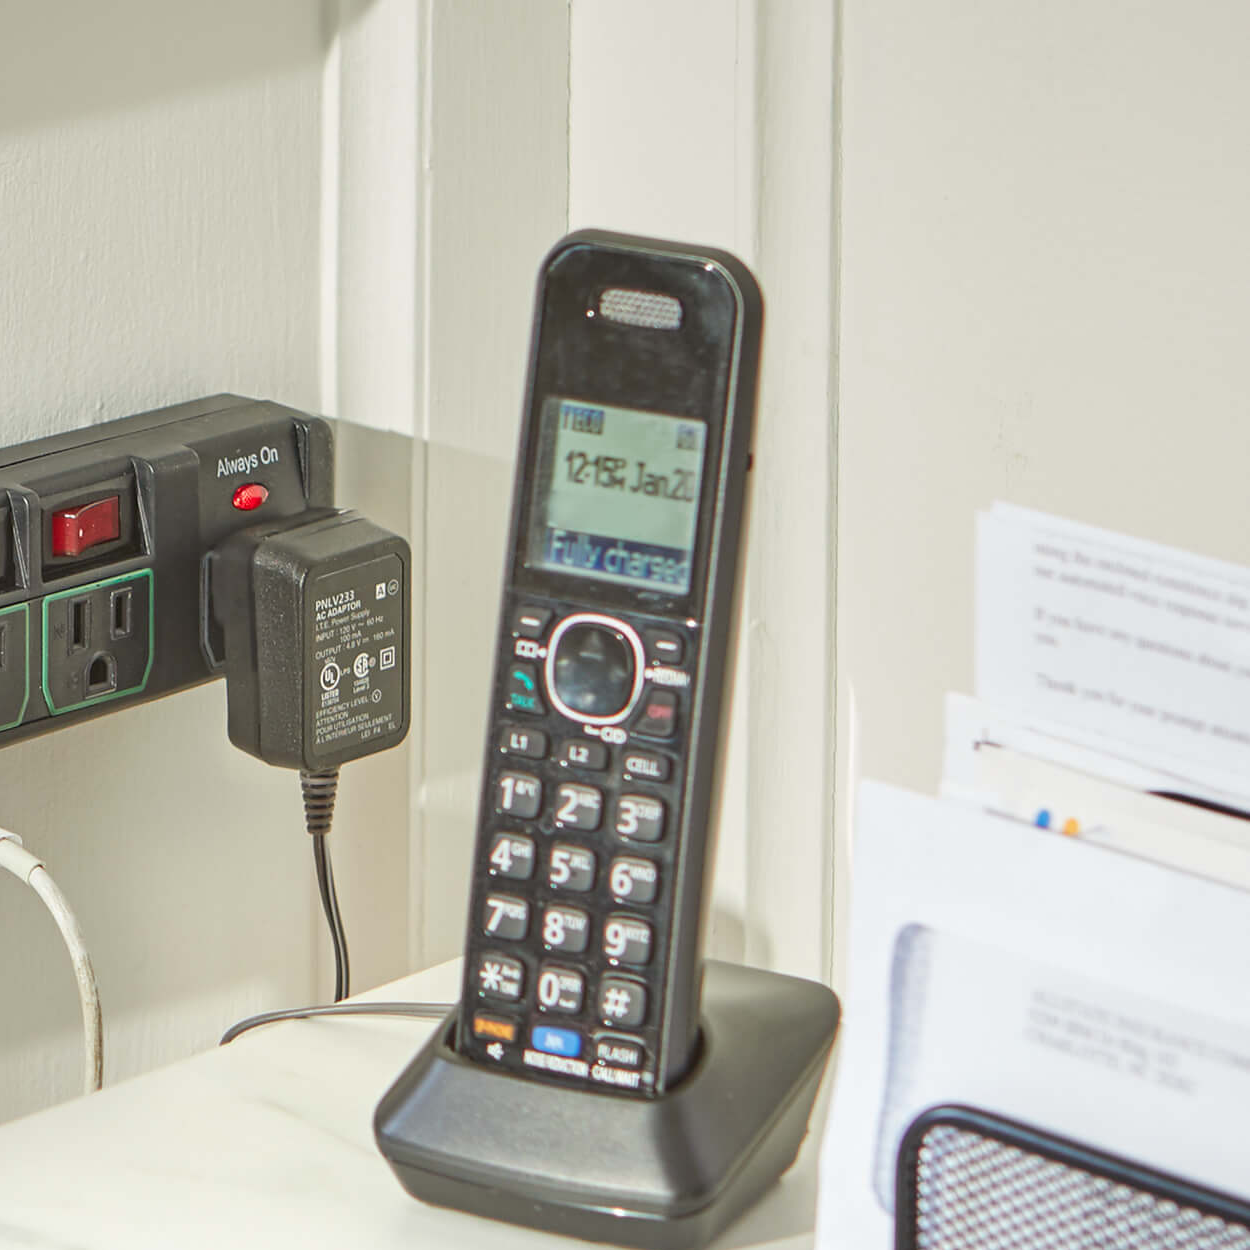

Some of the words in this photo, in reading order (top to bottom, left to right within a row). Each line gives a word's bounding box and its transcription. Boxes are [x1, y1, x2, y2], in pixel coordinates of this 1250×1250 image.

[217, 454, 258, 478] Always
[260, 446, 279, 465] On
[550, 529, 602, 569] Fully
[315, 590, 355, 611] PNLV233
[316, 611, 327, 621] AC
[510, 733, 528, 751] L1
[568, 745, 589, 763] L2
[625, 756, 660, 776] CELL
[501, 777, 515, 810] 1
[557, 788, 579, 823] 2
[616, 800, 638, 835] 3
[490, 839, 512, 872] 4
[550, 850, 570, 884] 5
[611, 863, 632, 896] 6
[486, 898, 504, 932] 7
[543, 911, 565, 945] 8
[605, 923, 627, 957] 9
[539, 972, 559, 1007] 0
